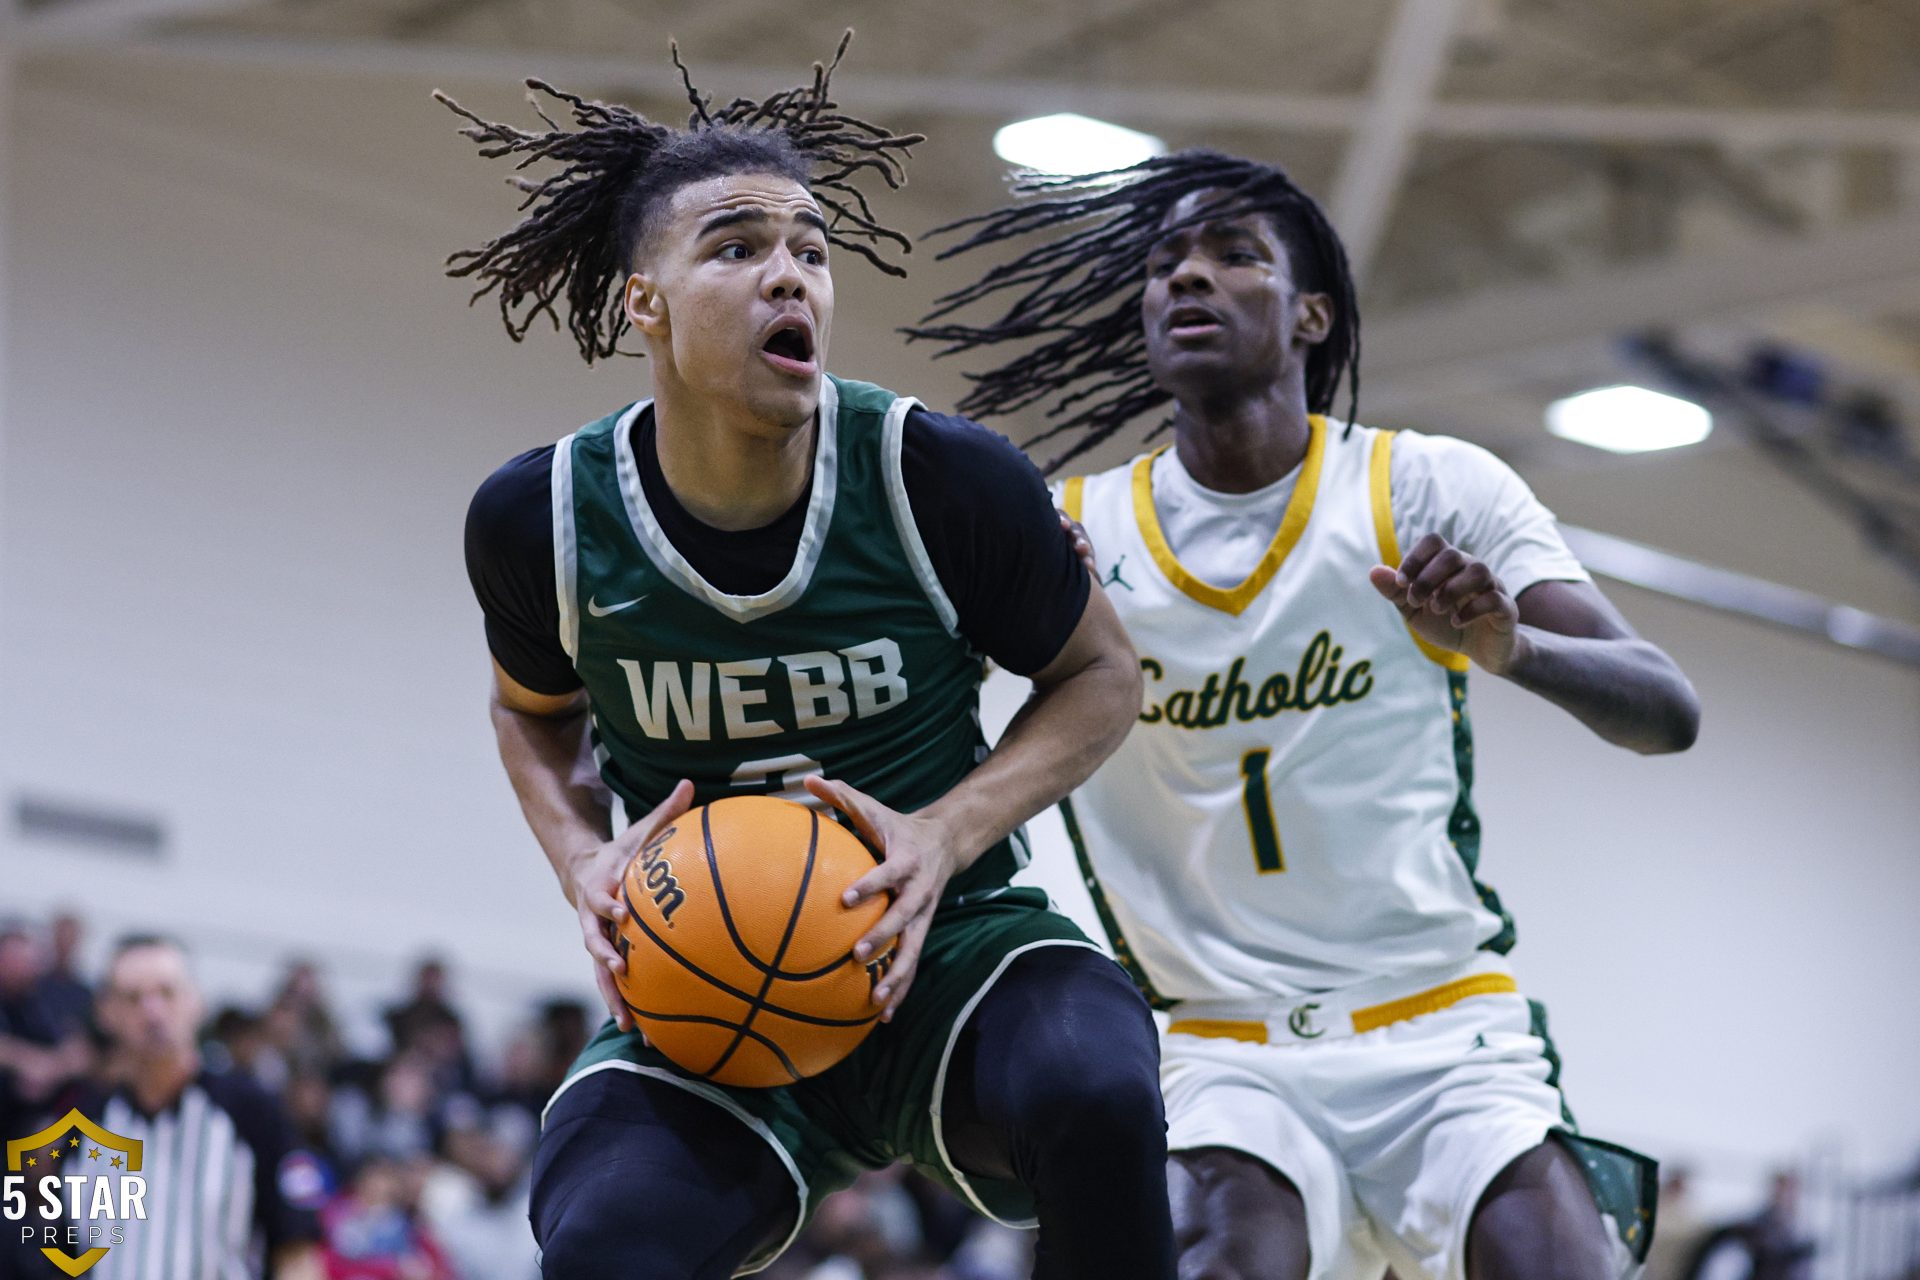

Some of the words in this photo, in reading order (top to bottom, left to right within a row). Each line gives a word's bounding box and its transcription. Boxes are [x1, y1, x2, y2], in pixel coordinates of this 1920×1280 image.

[617, 637, 908, 741] WEBB
[1240, 747, 1285, 874] 1
[639, 826, 686, 922] lson
